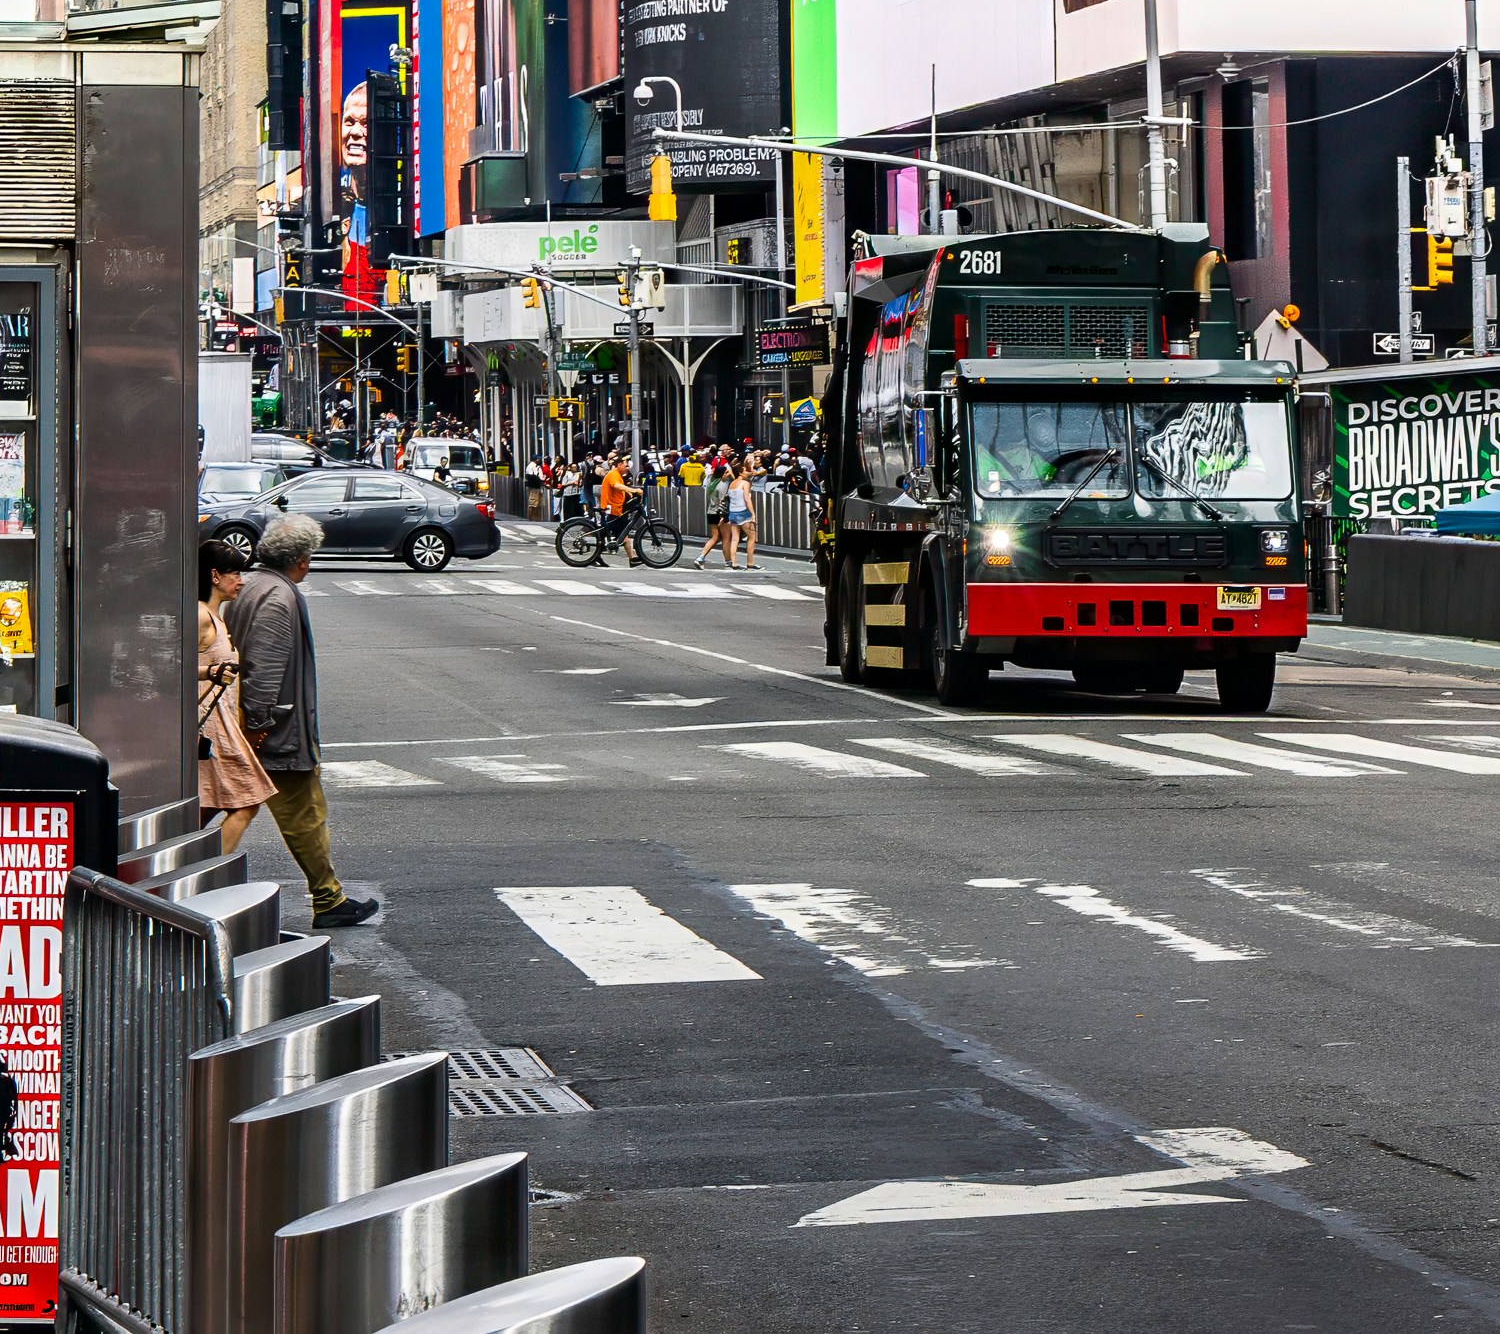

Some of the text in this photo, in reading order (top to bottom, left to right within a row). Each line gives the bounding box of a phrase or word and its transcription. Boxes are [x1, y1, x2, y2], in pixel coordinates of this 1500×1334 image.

[538, 224, 598, 261] pelé
[960, 251, 1002, 274] 2681
[1052, 534, 1225, 559] BATTLE
[45, 845, 67, 867] BE
[6, 1246, 21, 1262] GET
